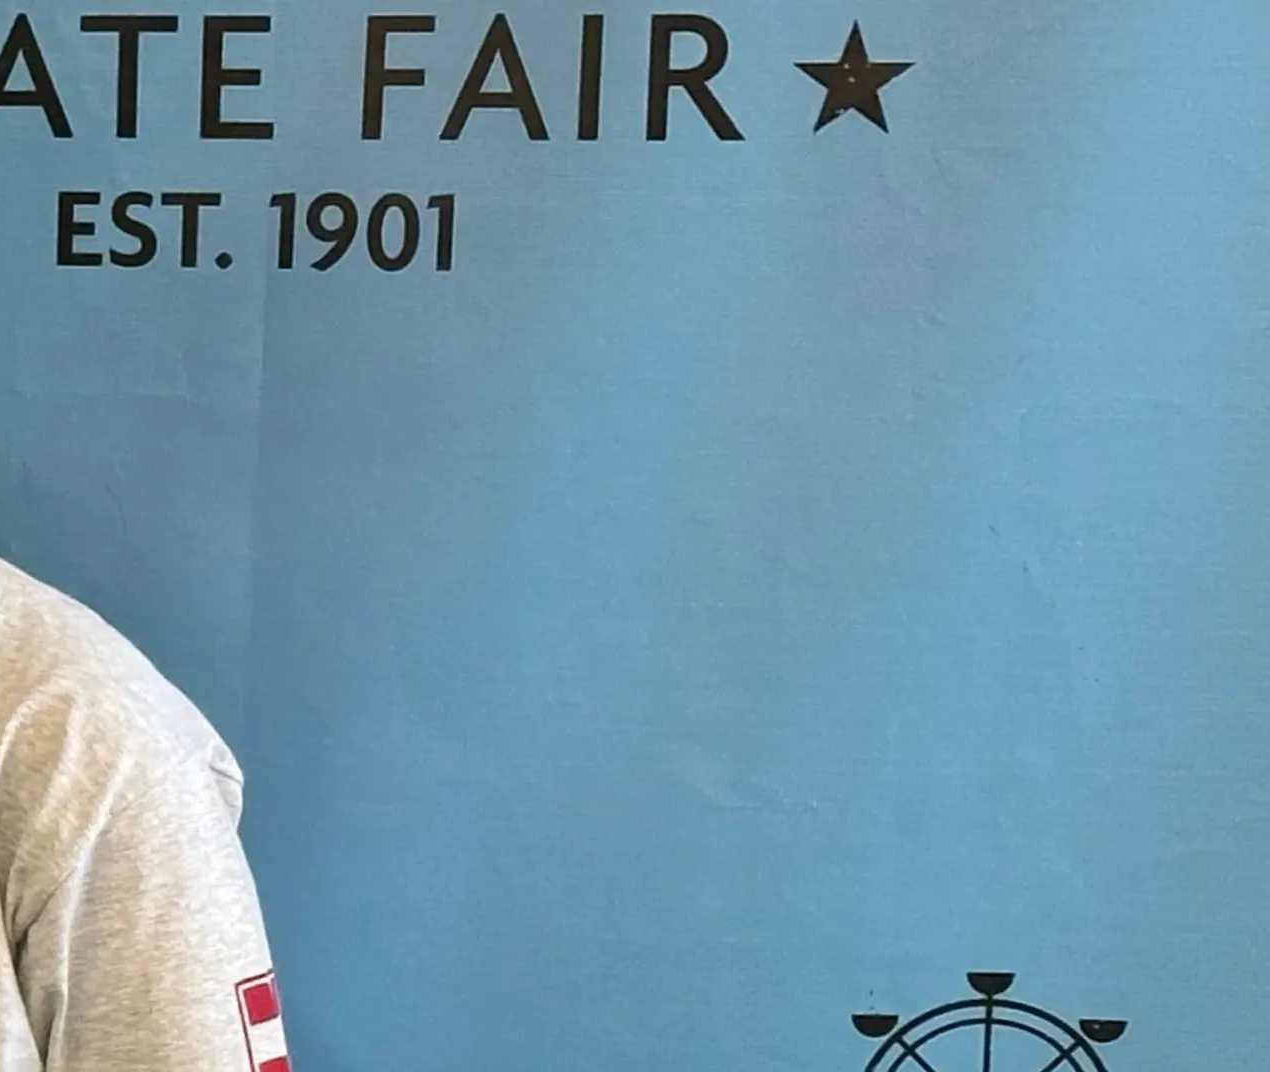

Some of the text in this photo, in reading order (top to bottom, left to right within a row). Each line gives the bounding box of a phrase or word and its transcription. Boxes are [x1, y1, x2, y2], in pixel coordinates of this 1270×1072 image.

[361, 12, 746, 143] FAIR
[55, 191, 456, 272] EST. 1901
